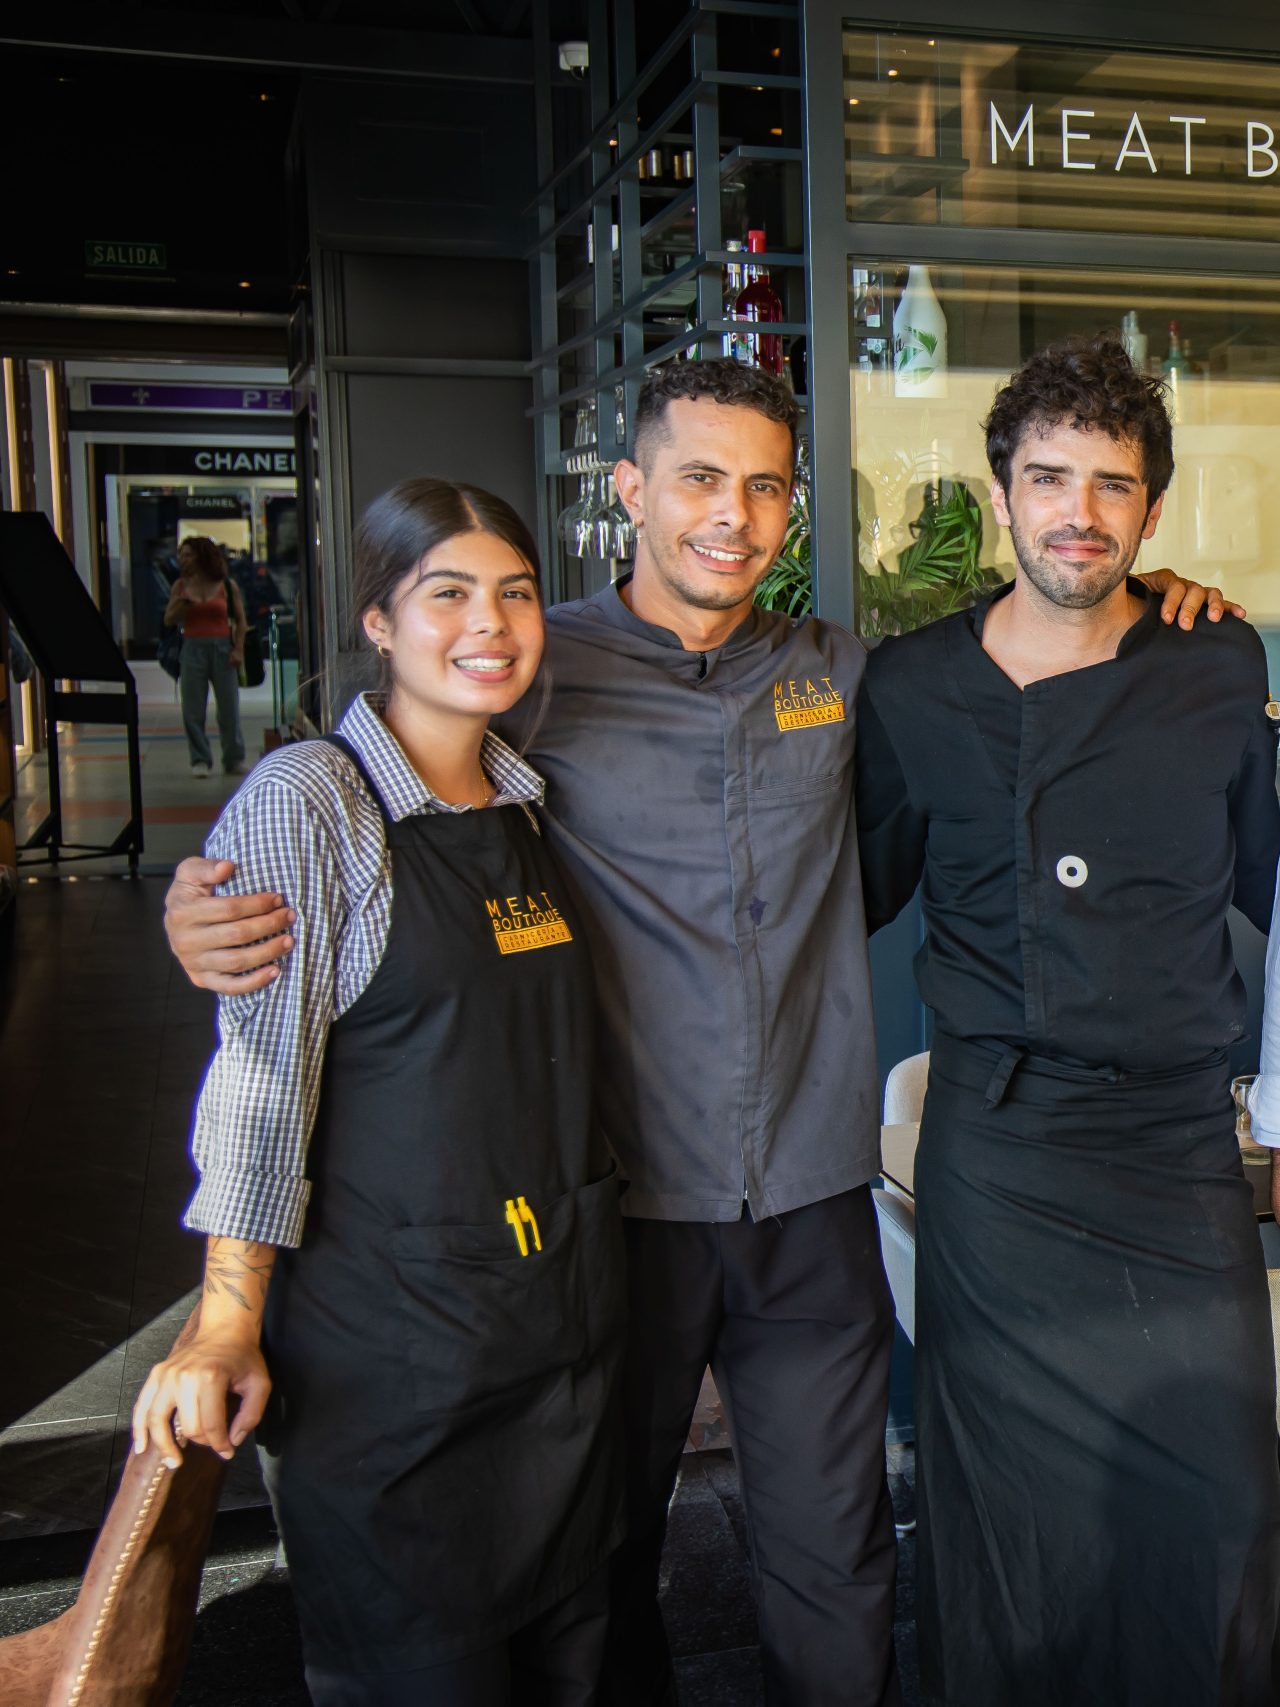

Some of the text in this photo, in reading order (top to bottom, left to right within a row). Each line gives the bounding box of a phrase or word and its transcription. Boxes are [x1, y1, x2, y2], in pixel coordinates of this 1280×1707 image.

[989, 100, 1207, 175] MEAT
[94, 246, 160, 265] SALIDA
[186, 497, 236, 508] CHANEL
[774, 677, 833, 699] MEAT
[774, 691, 843, 711] BOUTIQUE
[485, 892, 552, 918] MEAT
[492, 908, 563, 932] BOUTIQUE
